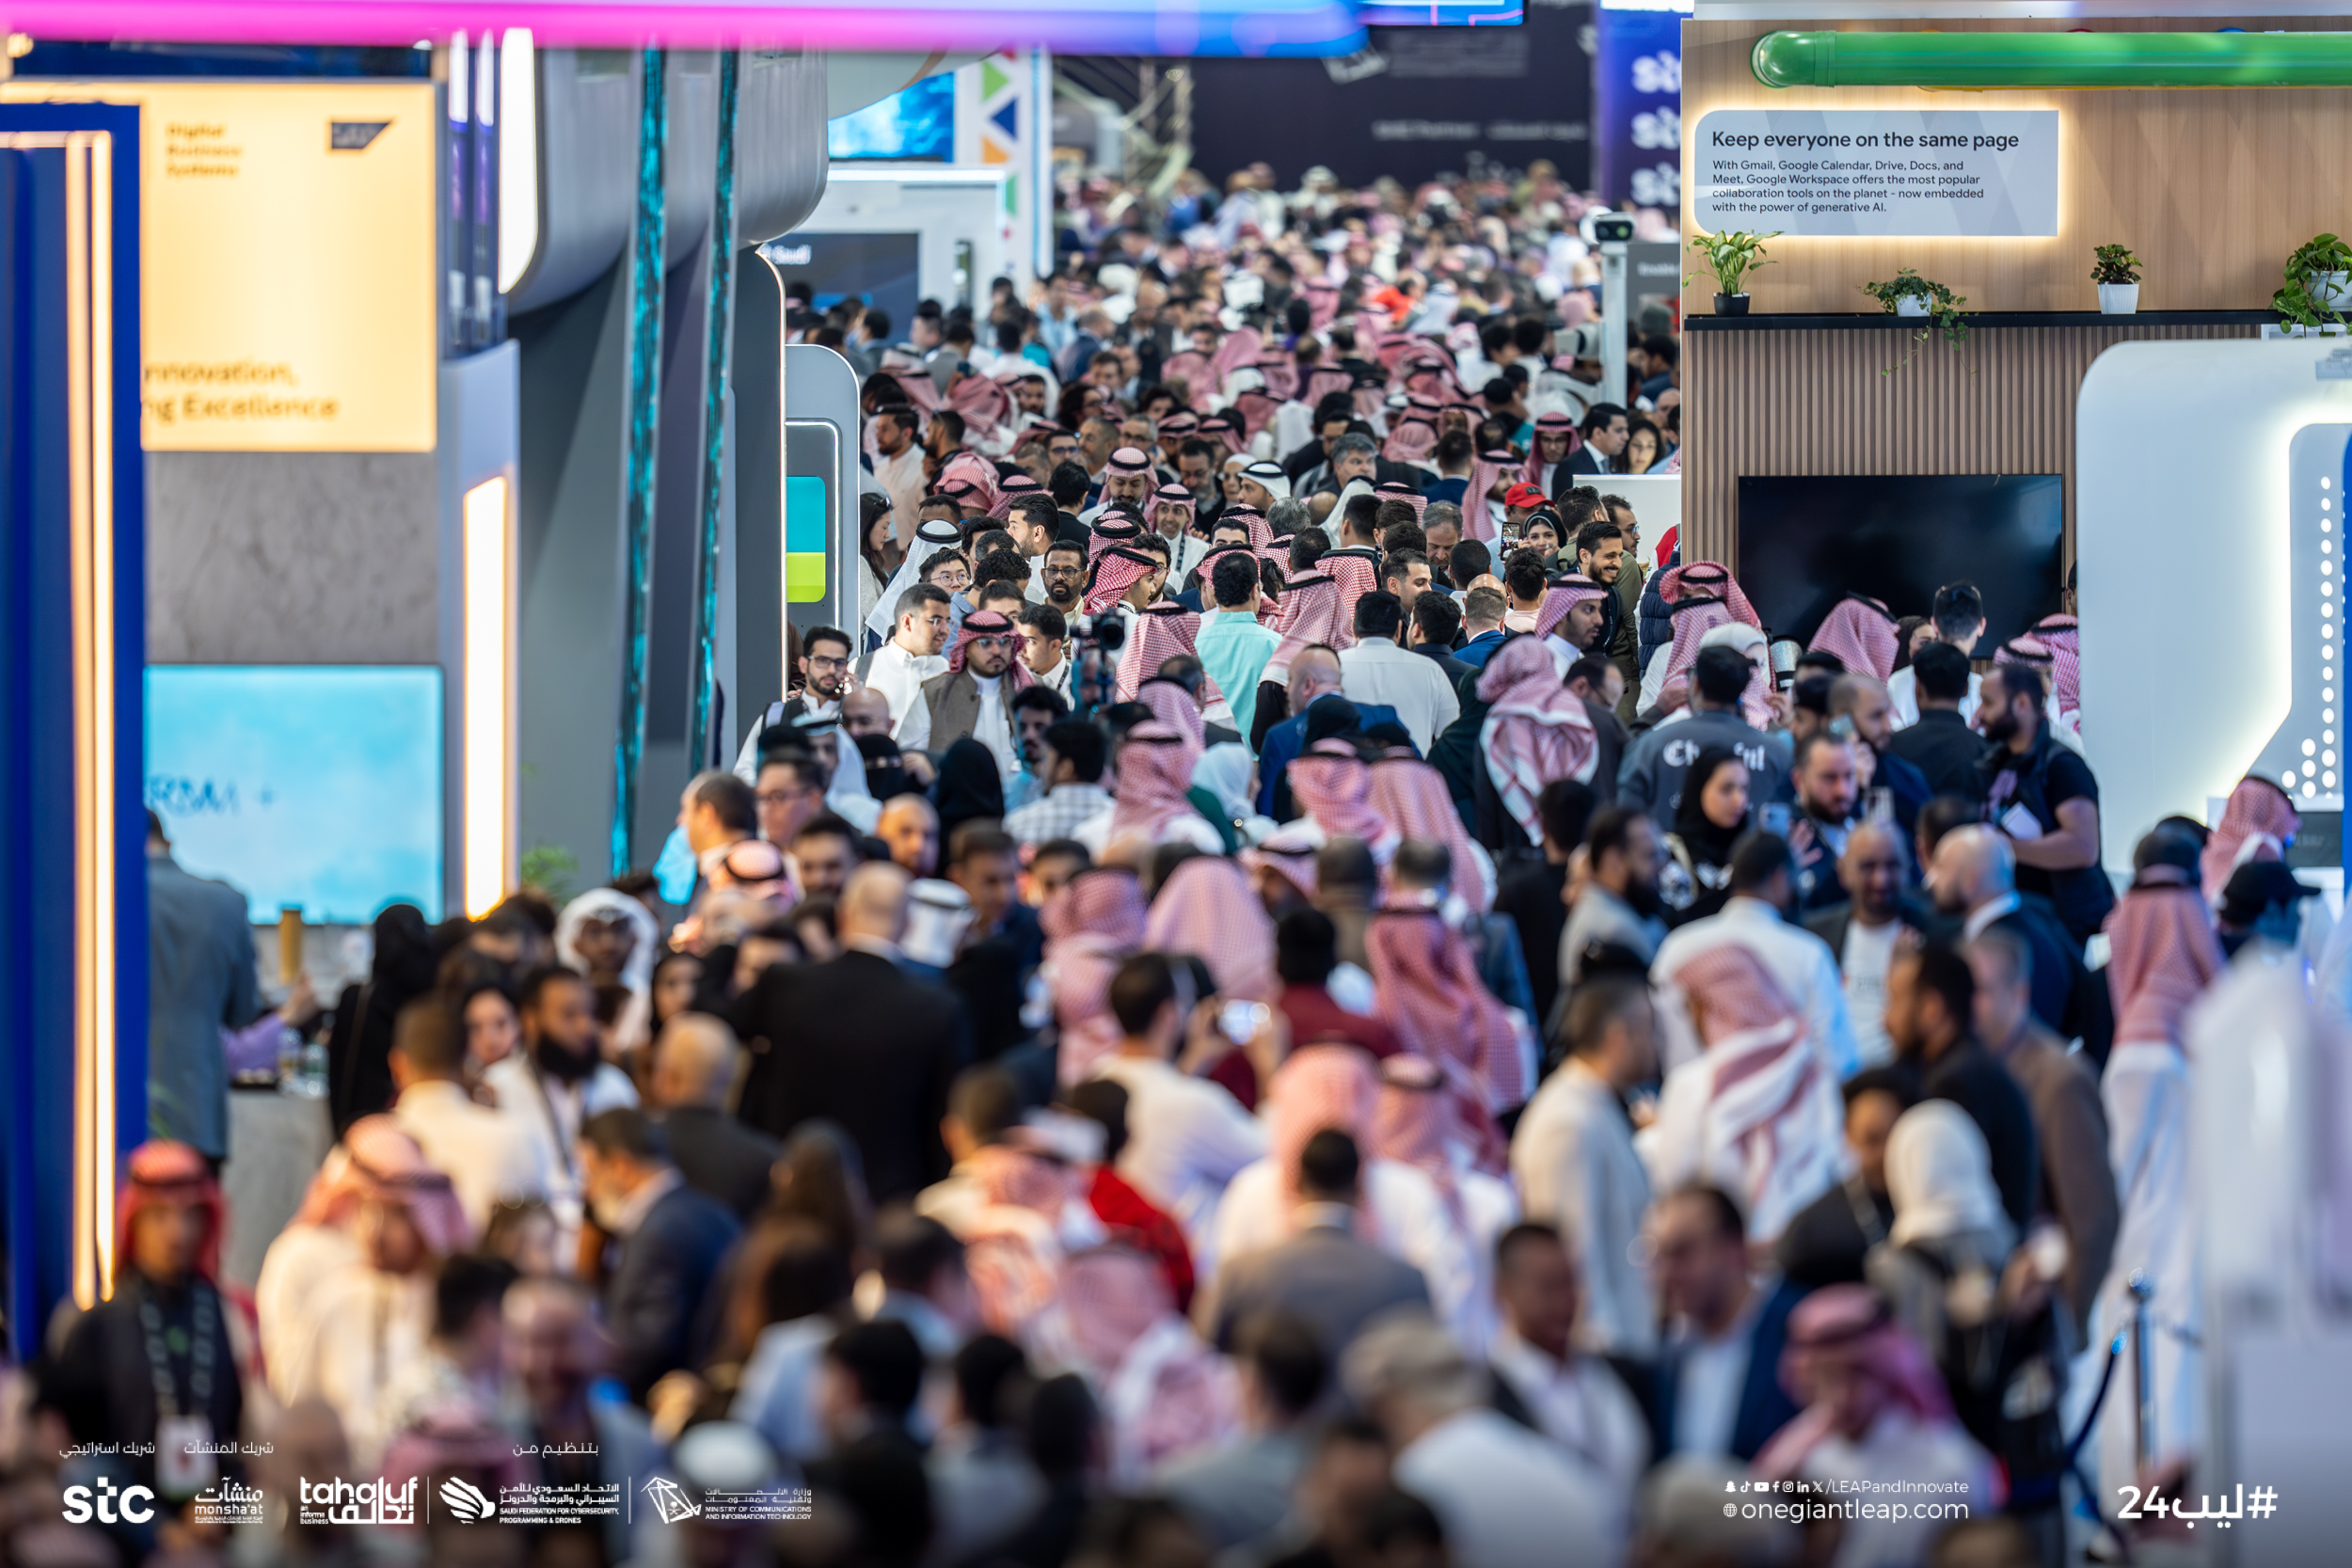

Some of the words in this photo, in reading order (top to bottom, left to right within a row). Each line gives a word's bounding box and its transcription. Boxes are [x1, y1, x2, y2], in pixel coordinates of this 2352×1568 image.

[1712, 131, 1759, 150] Keep
[1764, 135, 1851, 150] everyone
[1855, 135, 1879, 147] on
[1883, 132, 1915, 147] the
[1918, 135, 1969, 147] same
[1973, 135, 2020, 151] page
[1712, 160, 1739, 170] With
[1740, 160, 1776, 171] Gmail,
[1778, 160, 1819, 172] Google
[1820, 160, 1872, 171] Calendar,
[1875, 161, 1907, 171] Drive,
[1910, 161, 1940, 171] Docs,
[1943, 161, 1964, 170] and
[1712, 174, 1744, 185] Meet,
[1746, 174, 1787, 186] Google
[1788, 174, 1850, 186] Workspace
[1851, 175, 1884, 184] offers
[1886, 175, 1905, 184] the
[1907, 176, 1936, 184] most
[1938, 175, 1980, 186] popular
[1712, 188, 1785, 198] collaboration
[1787, 188, 1814, 198] tools
[1816, 190, 1831, 198] on
[1833, 188, 1851, 198] the
[1853, 188, 1888, 200] planet
[1898, 190, 1922, 198] now
[1924, 188, 1984, 198] embedded
[1712, 202, 1736, 212] with
[1738, 202, 1757, 212] the
[1759, 203, 1795, 214] power
[1797, 202, 1809, 212] of
[1811, 202, 1870, 214] generative
[1872, 202, 1887, 213] AI.
